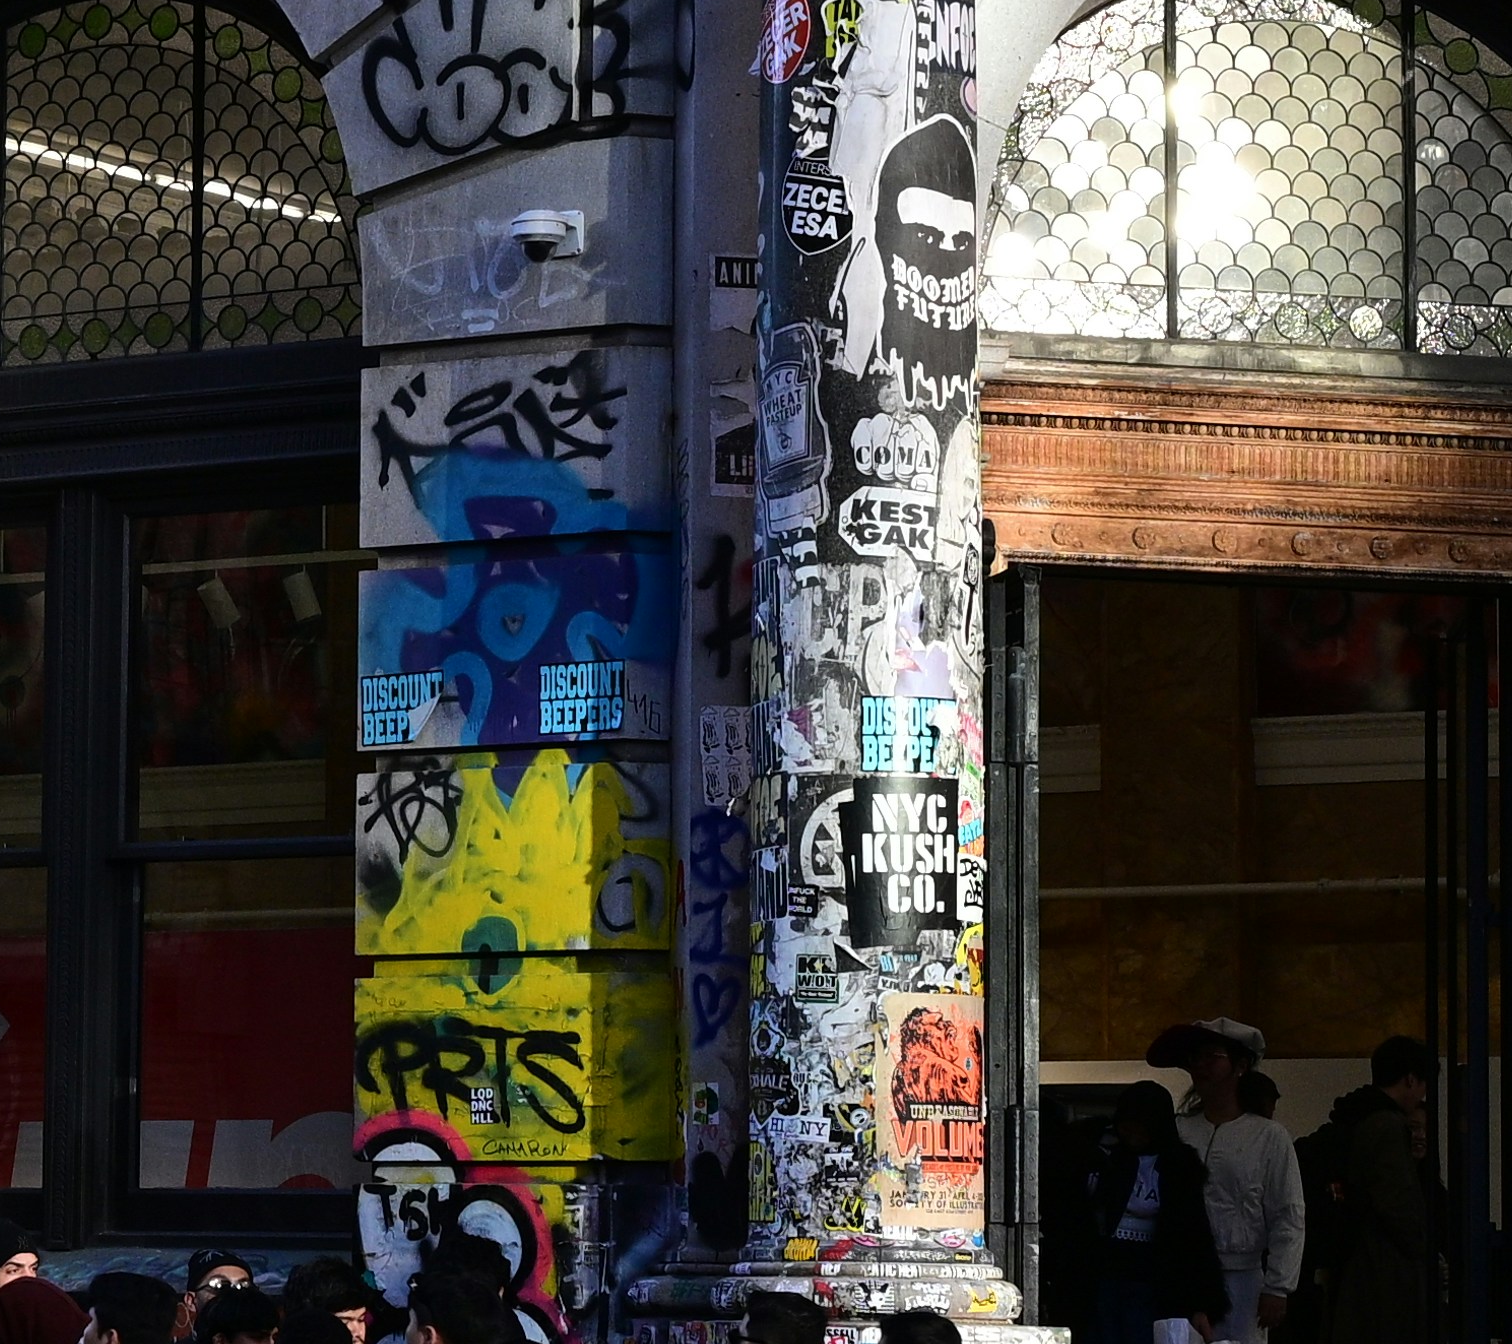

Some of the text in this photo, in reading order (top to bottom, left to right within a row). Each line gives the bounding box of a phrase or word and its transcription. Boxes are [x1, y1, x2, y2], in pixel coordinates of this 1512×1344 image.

[782, 181, 849, 216] ZECE
[790, 211, 839, 241] ESA
[762, 388, 803, 415] WHEAT
[765, 403, 803, 426] PASTEUP
[855, 445, 932, 469] COMA
[854, 522, 932, 550] GAK
[362, 671, 443, 712] DISCOUNT
[540, 661, 624, 700] DISCOUNT
[362, 710, 418, 746] BEEP
[540, 697, 624, 735] BEEPERS
[872, 793, 948, 834] NYC
[861, 832, 955, 874] KUSH
[887, 873, 946, 914] CO.
[470, 1088, 494, 1101] LQD
[470, 1100, 494, 1113] DNC
[470, 1112, 494, 1124] HLL
